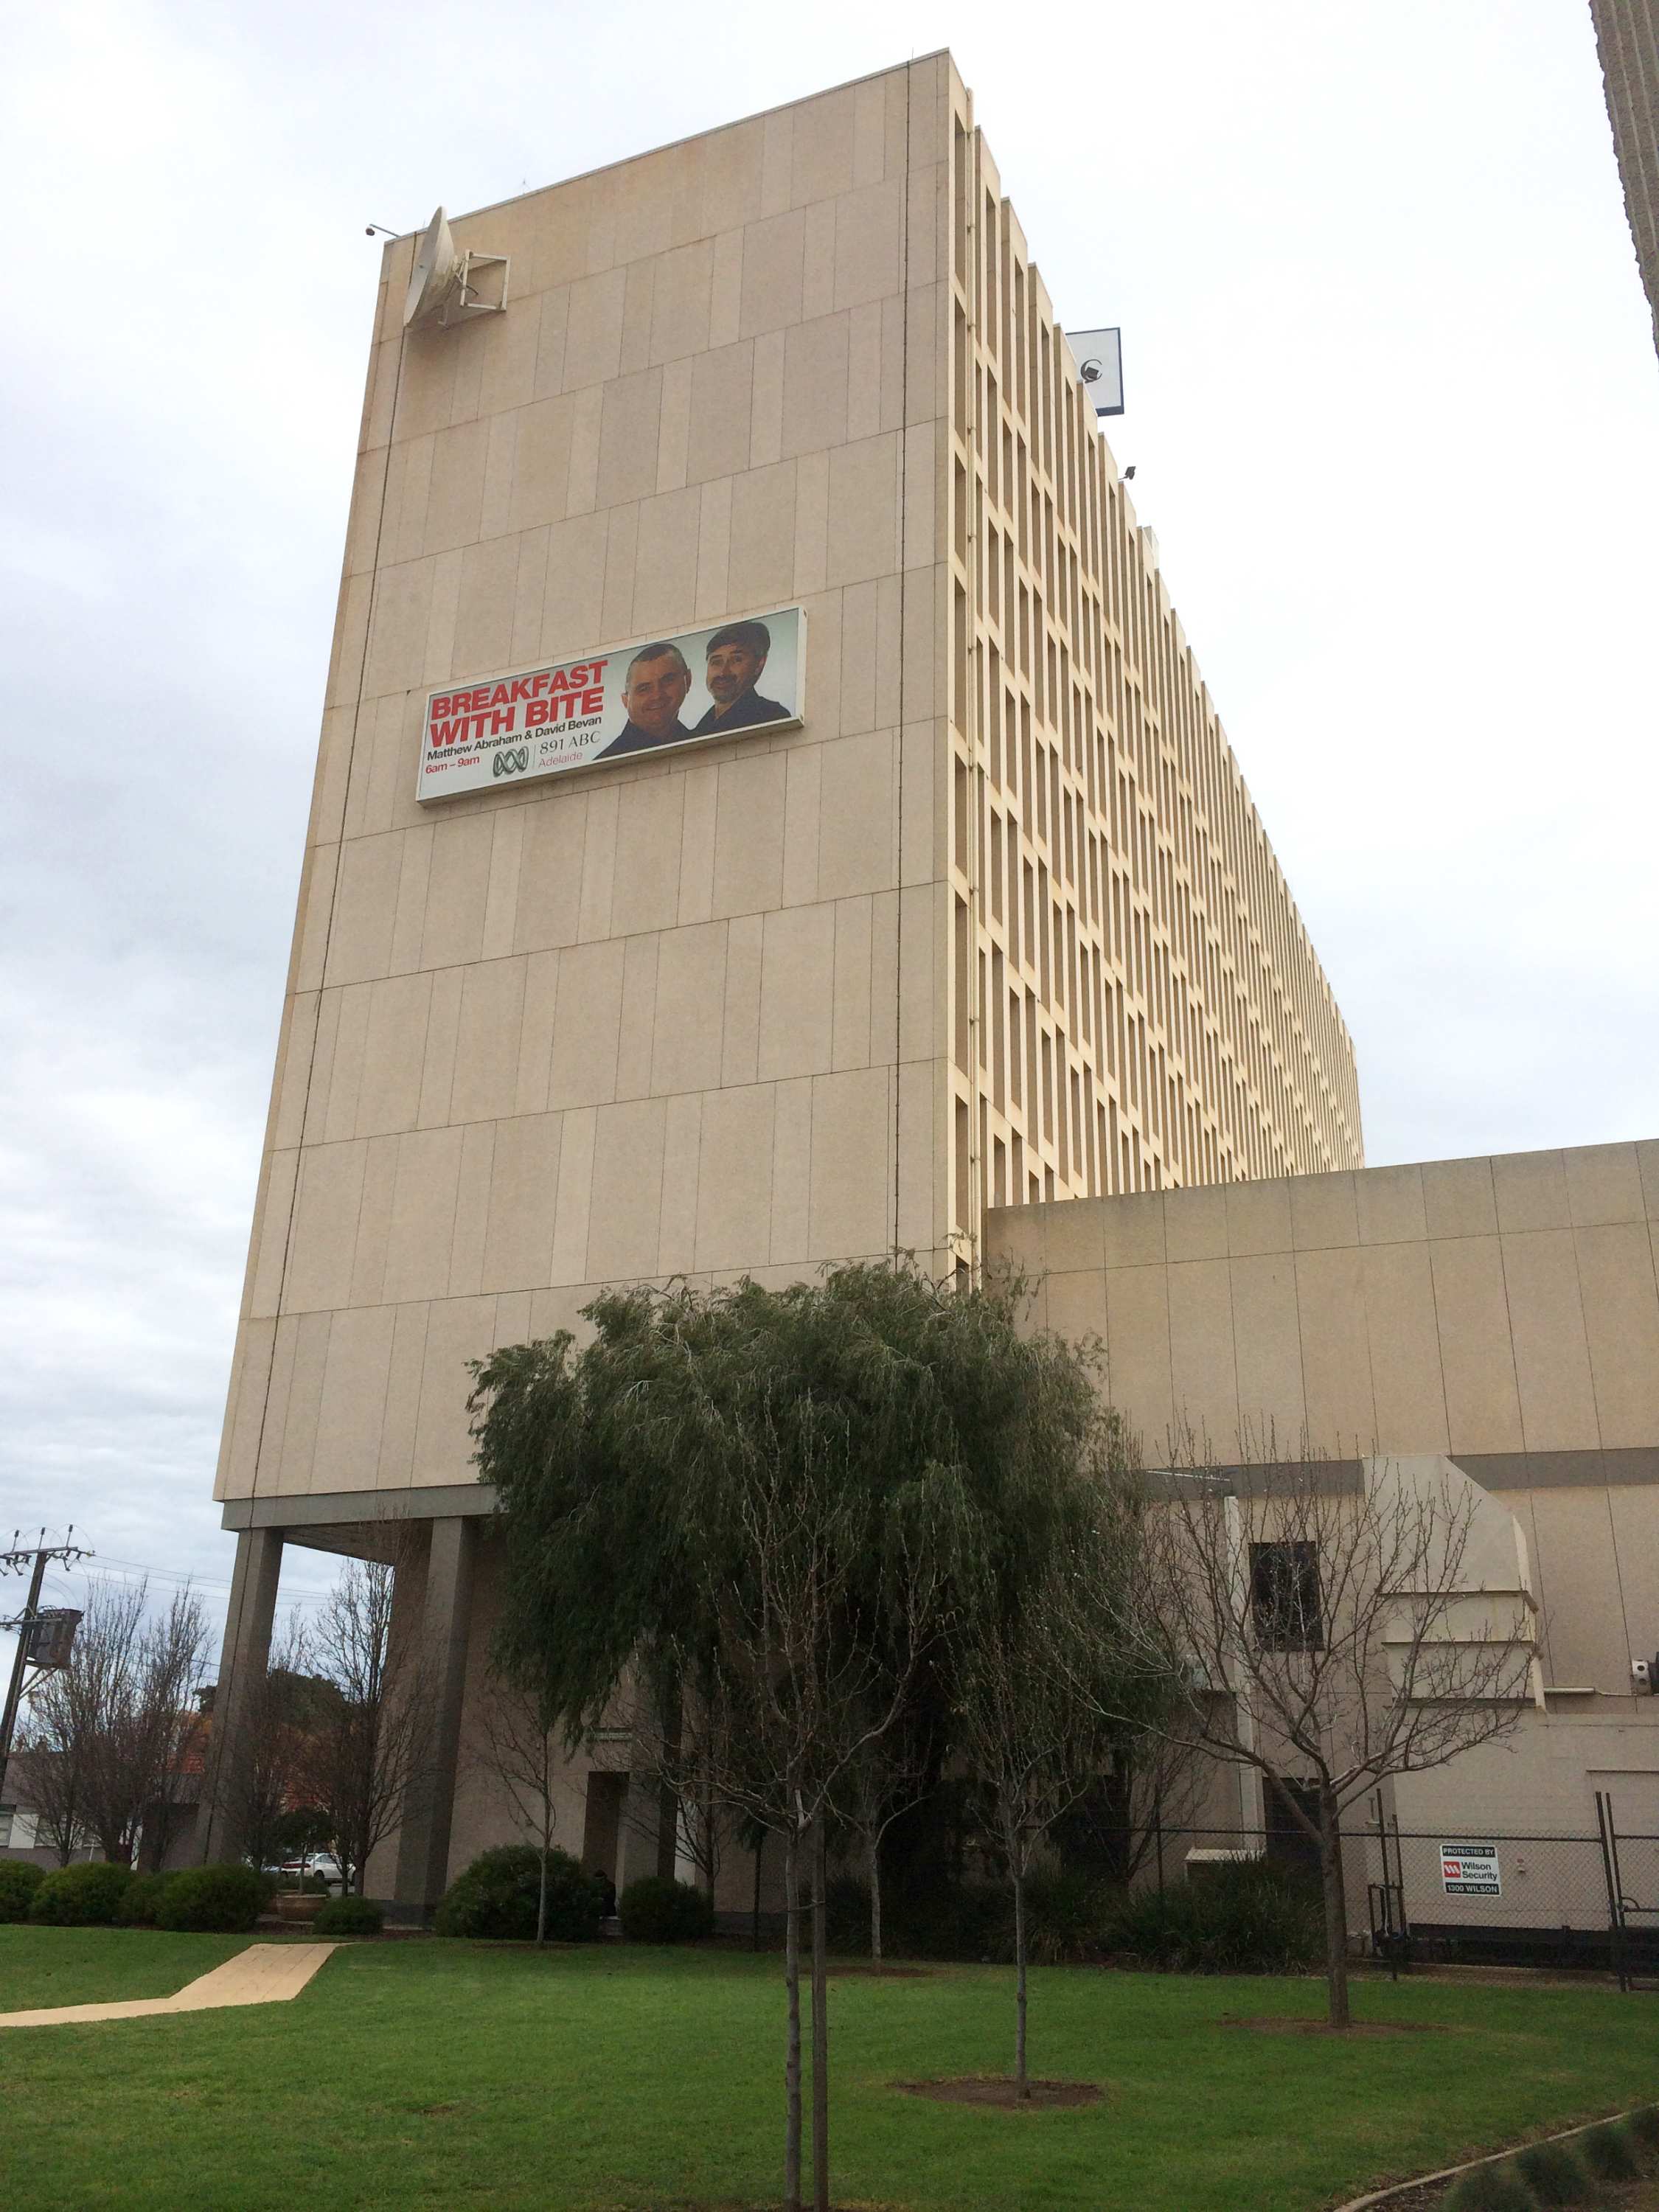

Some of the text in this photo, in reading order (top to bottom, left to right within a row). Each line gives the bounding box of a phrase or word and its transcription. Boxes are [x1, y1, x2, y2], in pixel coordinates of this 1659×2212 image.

[431, 660, 608, 720] BREAKFAST
[430, 686, 605, 748] WITH BITE
[428, 717, 602, 761] Matthew Abraham & David Bevan
[540, 731, 601, 755] 891 ABC
[425, 761, 448, 774] 6am
[457, 757, 479, 768] 9am
[538, 752, 583, 769] Adelaide
[1461, 1862, 1491, 1870] Wilson
[1462, 1871, 1498, 1881] Security
